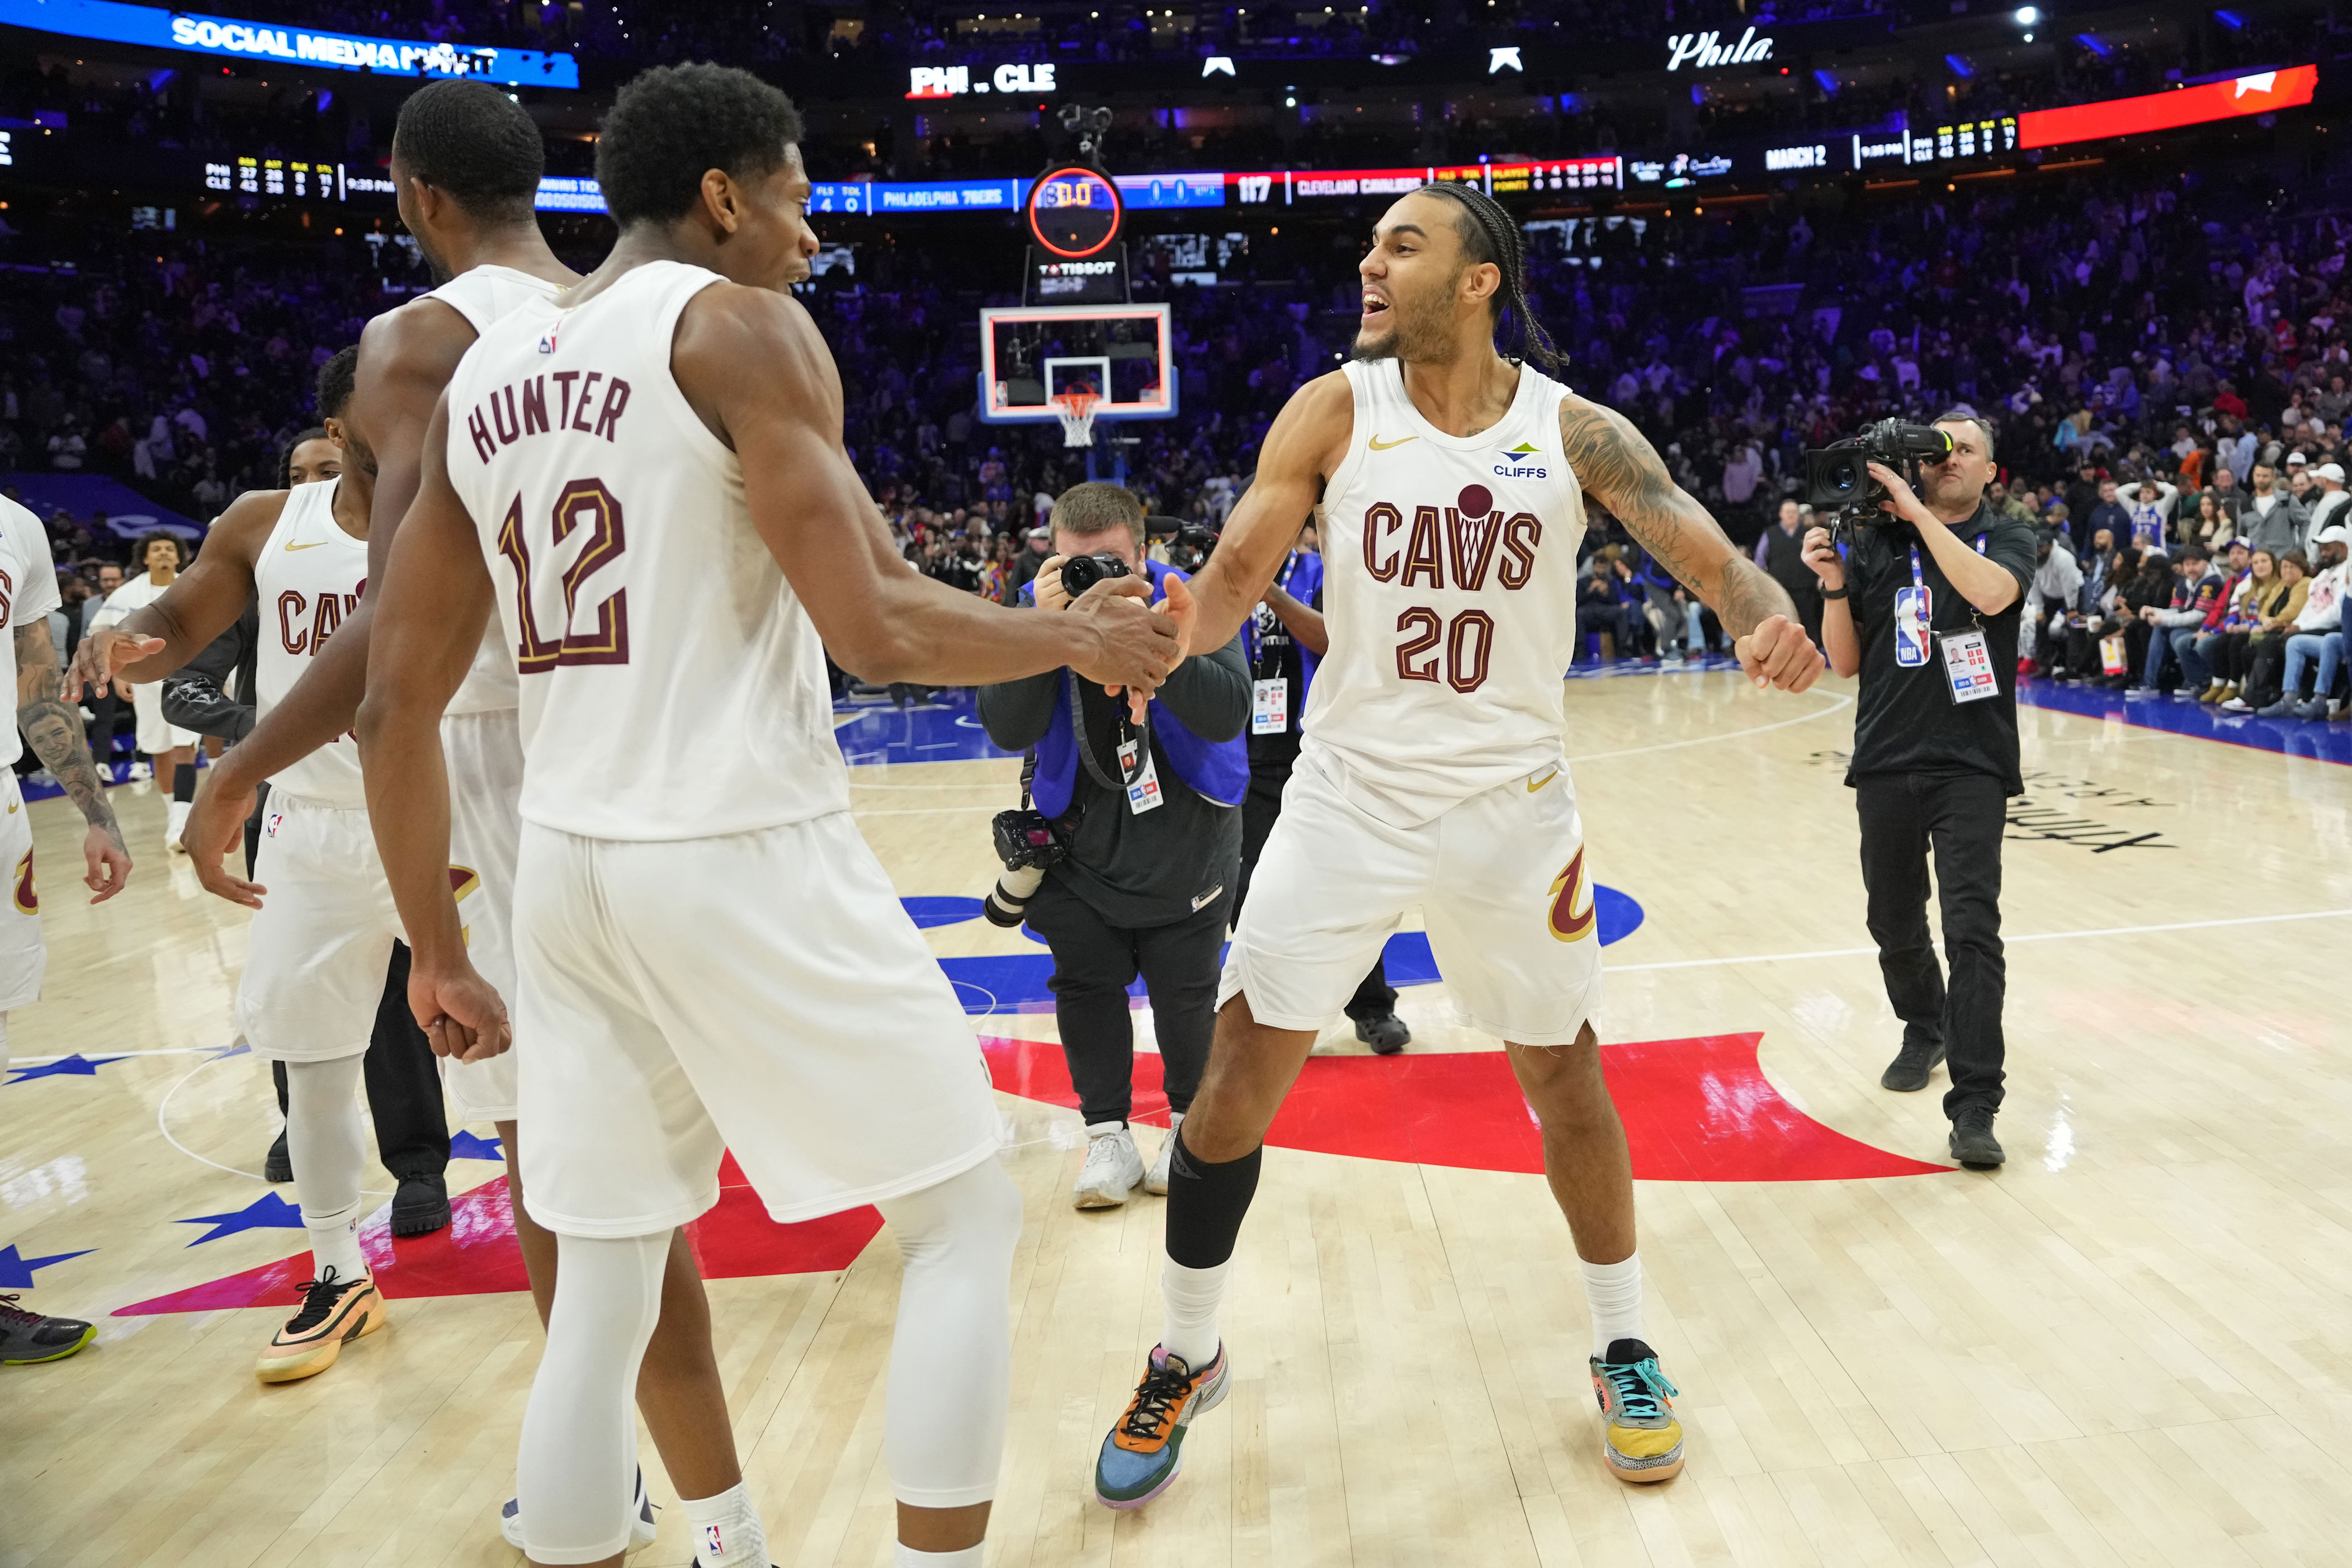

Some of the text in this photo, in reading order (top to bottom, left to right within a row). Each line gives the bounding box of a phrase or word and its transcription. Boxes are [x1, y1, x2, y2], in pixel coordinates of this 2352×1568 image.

[172, 17, 296, 59] SOCIAL
[297, 35, 400, 69] MEDIA
[1667, 26, 1773, 70] Phila
[994, 64, 1056, 92] CLE
[1766, 145, 1826, 170] MARCH 2
[1914, 149, 1933, 161] CLE
[1939, 145, 1954, 158] 42
[205, 176, 232, 191] CLE
[239, 178, 258, 192] 42
[321, 185, 331, 199] 7
[319, 173, 333, 186] 11
[1238, 176, 1272, 203] 117
[1297, 177, 1422, 196] CLEVELAND CAVALIERS
[820, 197, 858, 213] 4 0
[884, 188, 1002, 207] PHILADELPHIA 76ERS
[1060, 261, 1116, 276] TISSOT
[468, 371, 631, 465] HUNTER
[1494, 465, 1547, 479] CLIFFS
[1363, 502, 1543, 591] CAVS
[498, 477, 630, 674] 12
[278, 590, 357, 657] CA
[1396, 606, 1495, 694] 20
[1901, 646, 1918, 662] NBA
